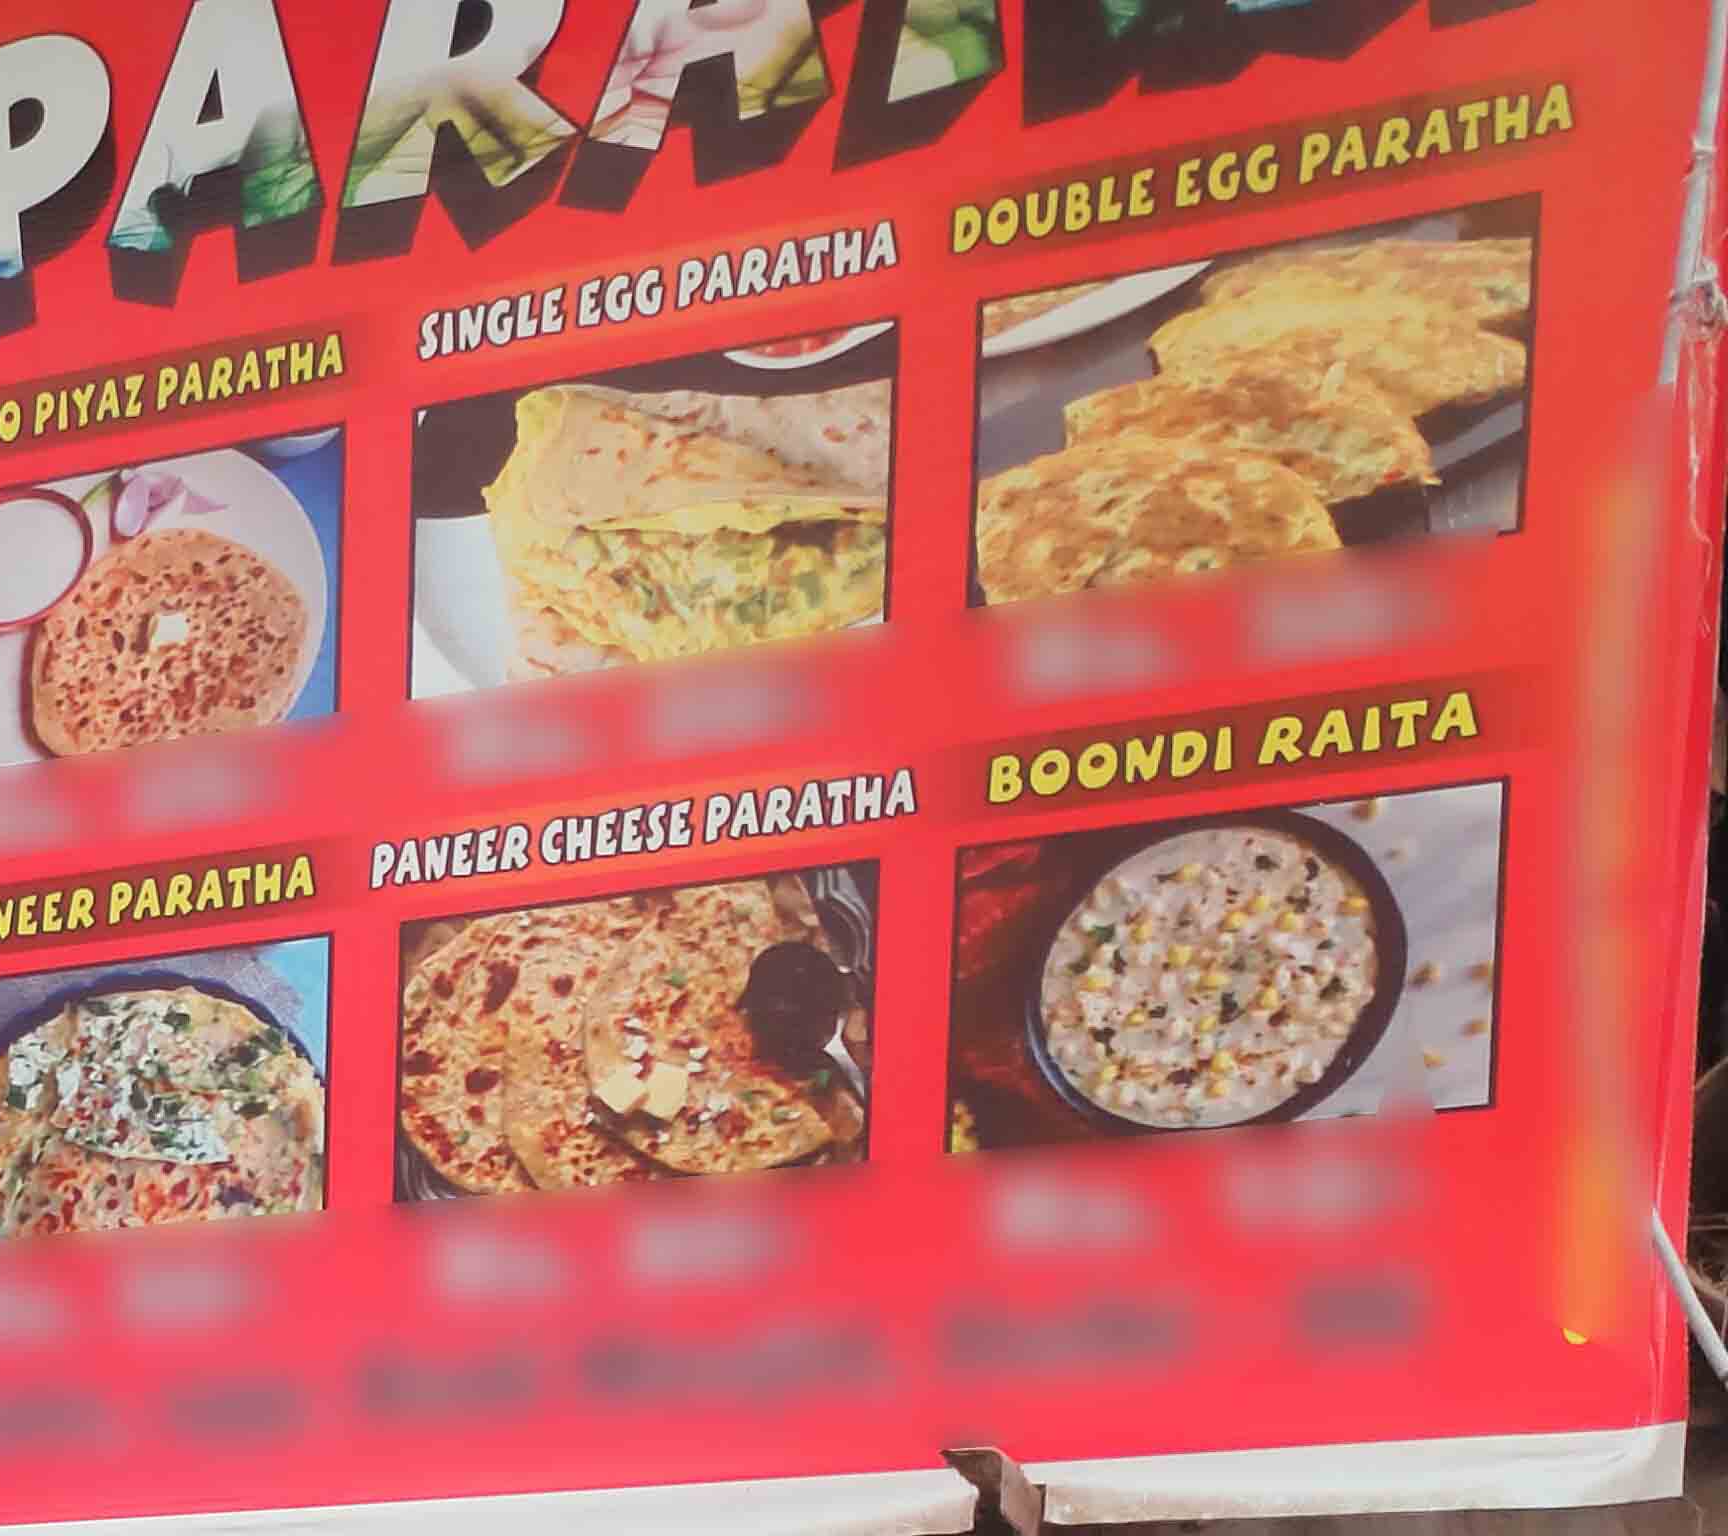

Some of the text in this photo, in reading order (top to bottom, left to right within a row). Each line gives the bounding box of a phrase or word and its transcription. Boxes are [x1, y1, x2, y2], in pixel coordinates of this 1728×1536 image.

[952, 84, 1574, 253] DOUBLE EGG PARATHA
[417, 220, 899, 361] SINGLE EGG PARATHA
[33, 373, 146, 436] PIYAZ
[157, 333, 345, 411] PARATHA
[988, 691, 1479, 803] BOONDI RAITA
[370, 768, 917, 888] PANEER CHEESE PARATHA
[108, 855, 316, 925] PARATHA
